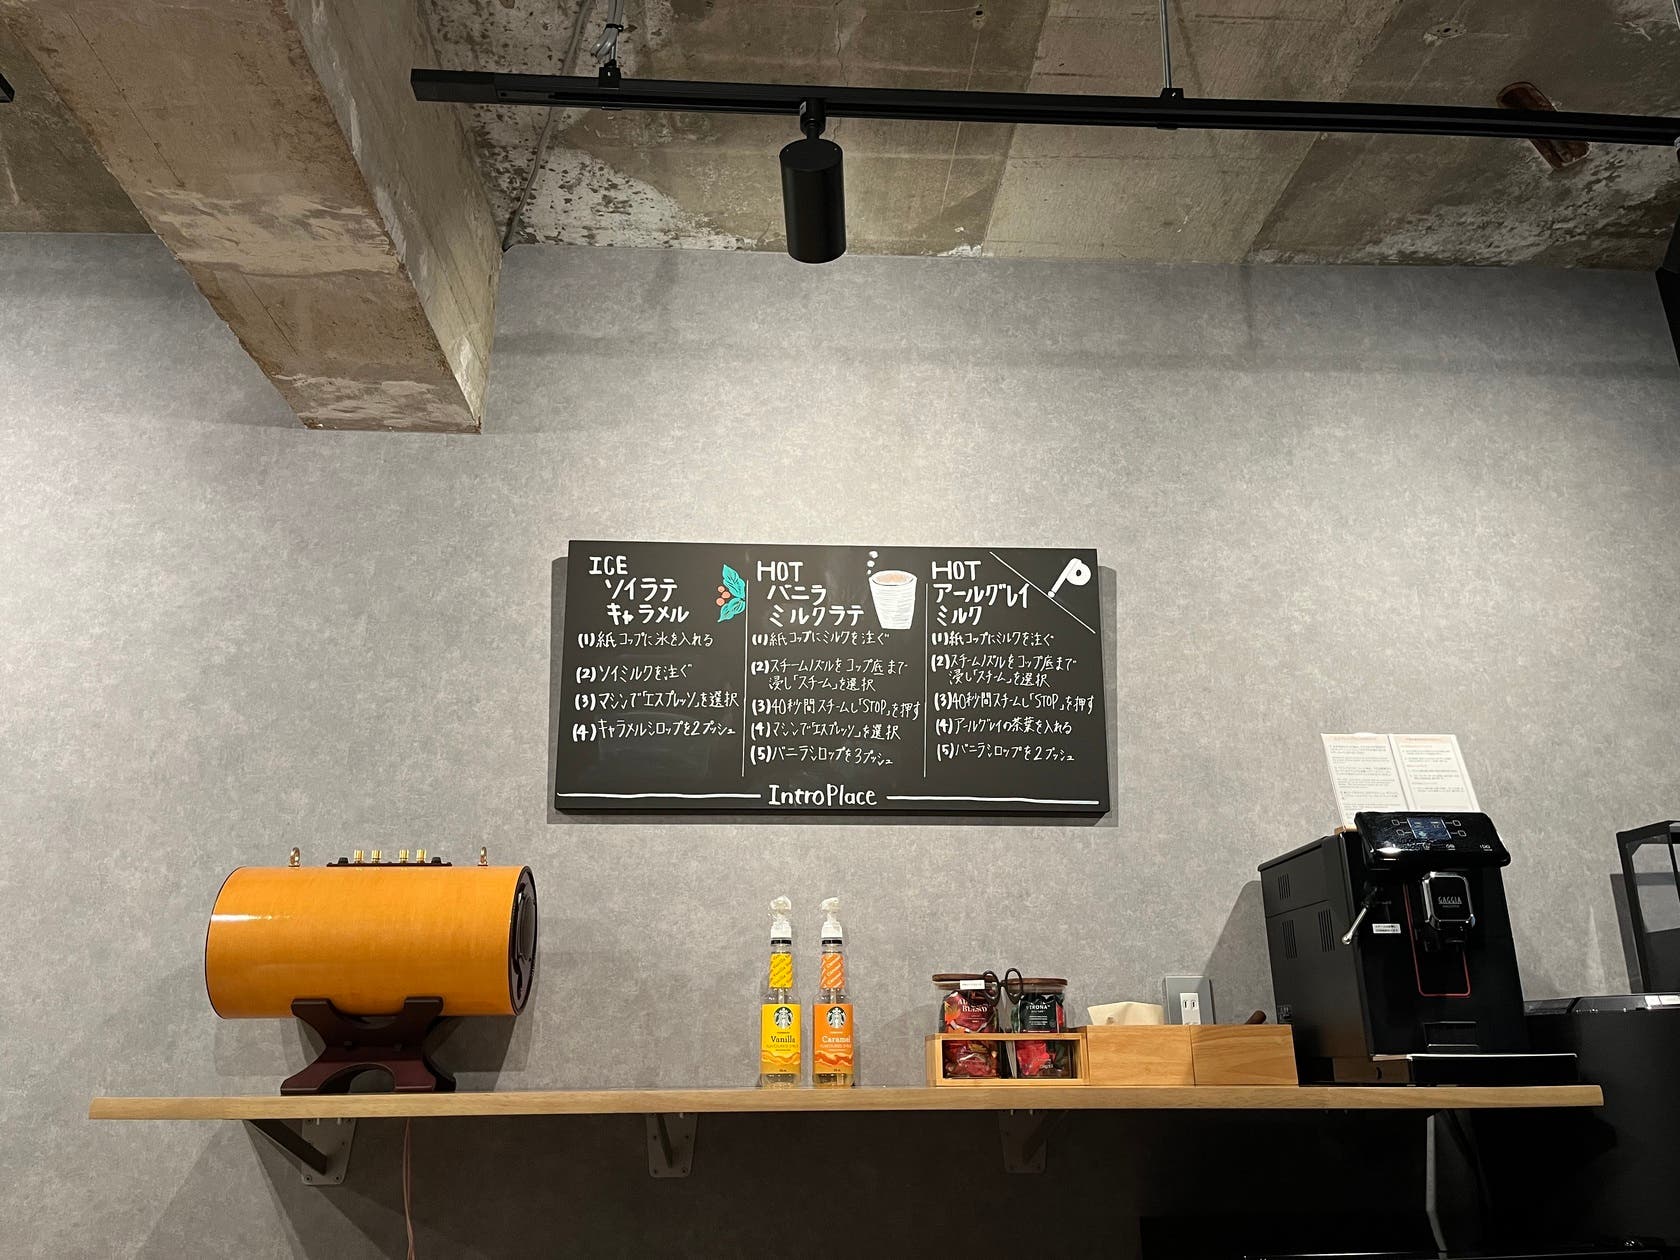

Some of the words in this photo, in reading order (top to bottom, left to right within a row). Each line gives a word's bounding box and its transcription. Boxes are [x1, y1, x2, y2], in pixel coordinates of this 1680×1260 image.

[588, 555, 629, 576] ICE
[756, 560, 804, 582] HOT
[931, 560, 982, 581] HOT
[604, 577, 678, 603] ソイラテ
[766, 584, 828, 606] バニラ
[933, 582, 1031, 609] アールグレイ
[606, 602, 690, 626] キャラメル
[768, 604, 865, 627] ミルクラテ
[936, 605, 983, 627] ミルク
[767, 783, 878, 807] IntroPlace
[770, 1035, 796, 1043] Vanilla
[821, 1035, 851, 1043] Caramel
